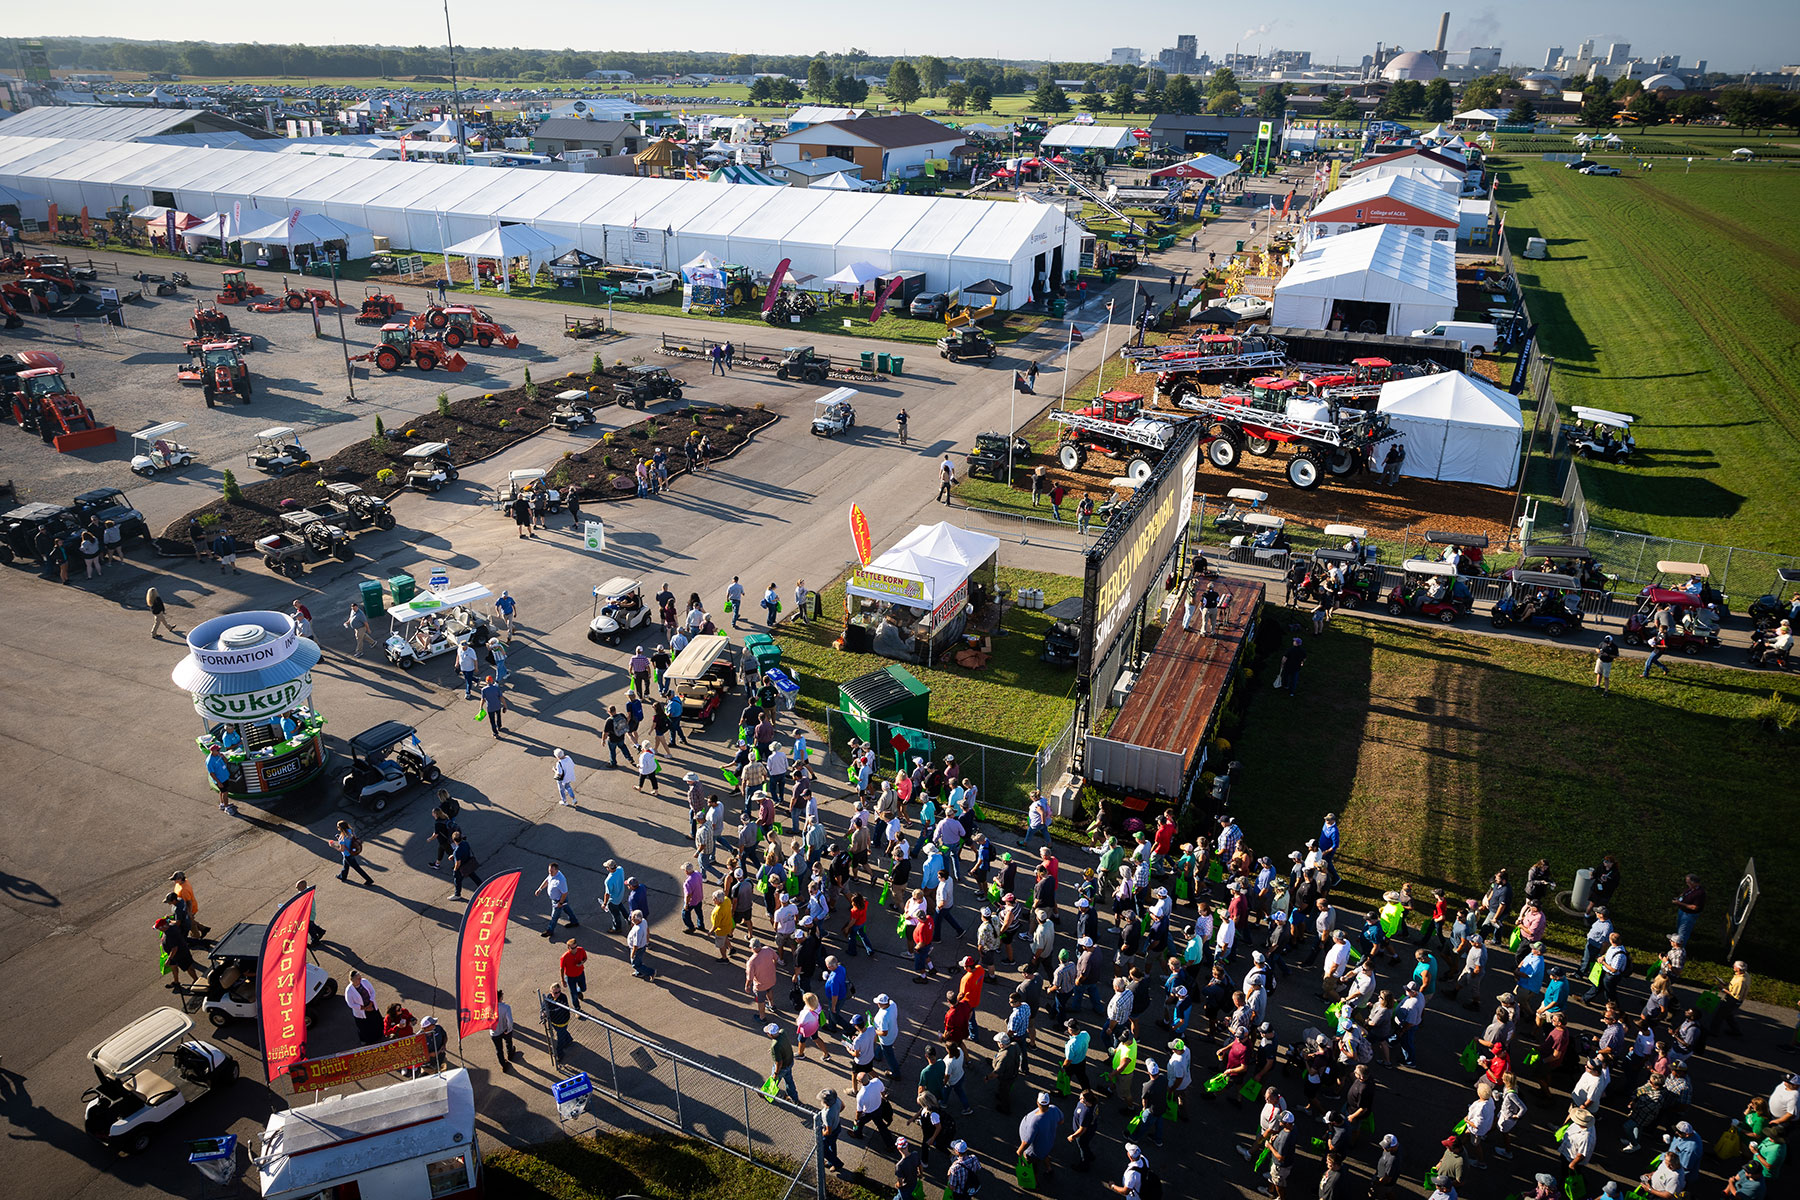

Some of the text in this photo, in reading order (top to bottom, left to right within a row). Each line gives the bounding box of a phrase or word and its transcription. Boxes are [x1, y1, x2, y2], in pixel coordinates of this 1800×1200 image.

[856, 570, 904, 586] KETTLE KORN
[867, 581, 889, 590] LEMON
[1097, 548, 1134, 621] FIERCELY
[933, 596, 953, 626] KETTLE
[1094, 604, 1117, 652] SINCE
[209, 685, 296, 713] Sukup
[265, 761, 297, 778] SOURCE
[475, 896, 509, 909] Mini
[473, 911, 494, 1004] DONUTS
[398, 1036, 416, 1048] HOT
[298, 1085, 307, 1093] A
[392, 1056, 428, 1070] Delight
[310, 1060, 348, 1077] Donut
